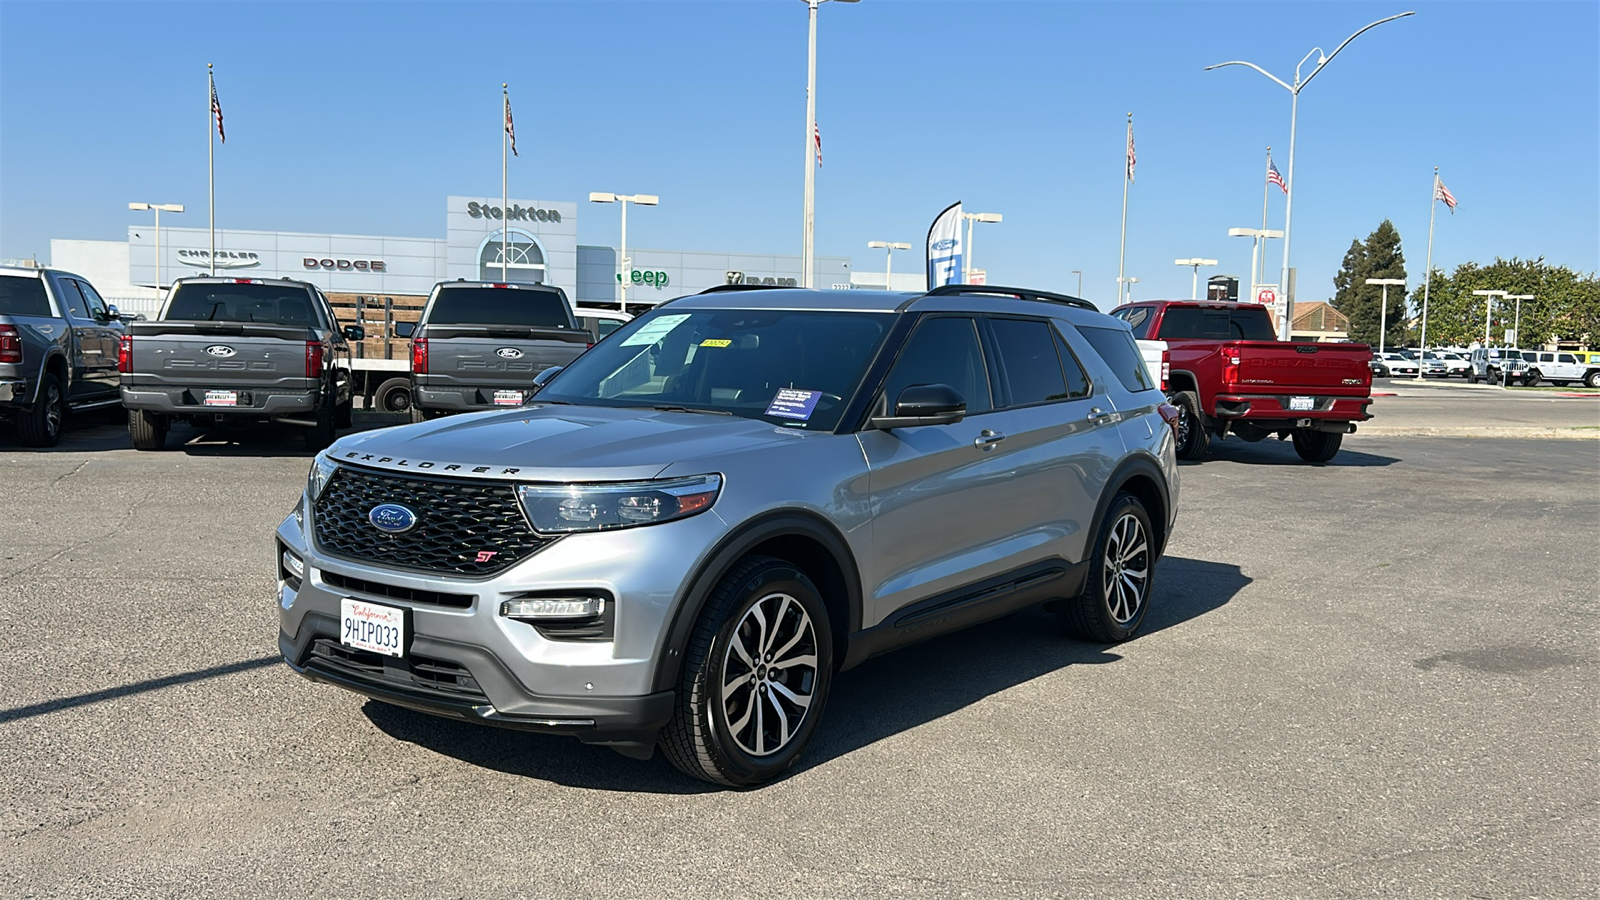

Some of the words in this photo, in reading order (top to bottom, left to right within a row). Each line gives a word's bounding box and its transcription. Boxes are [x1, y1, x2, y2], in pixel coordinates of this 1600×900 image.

[467, 201, 561, 222] Stockton
[303, 258, 386, 271] DODGE
[163, 359, 275, 371] F-150
[345, 452, 520, 475] EXPLORER
[475, 551, 497, 562] ST
[353, 605, 392, 622] California
[345, 618, 399, 648] 9HIP033
